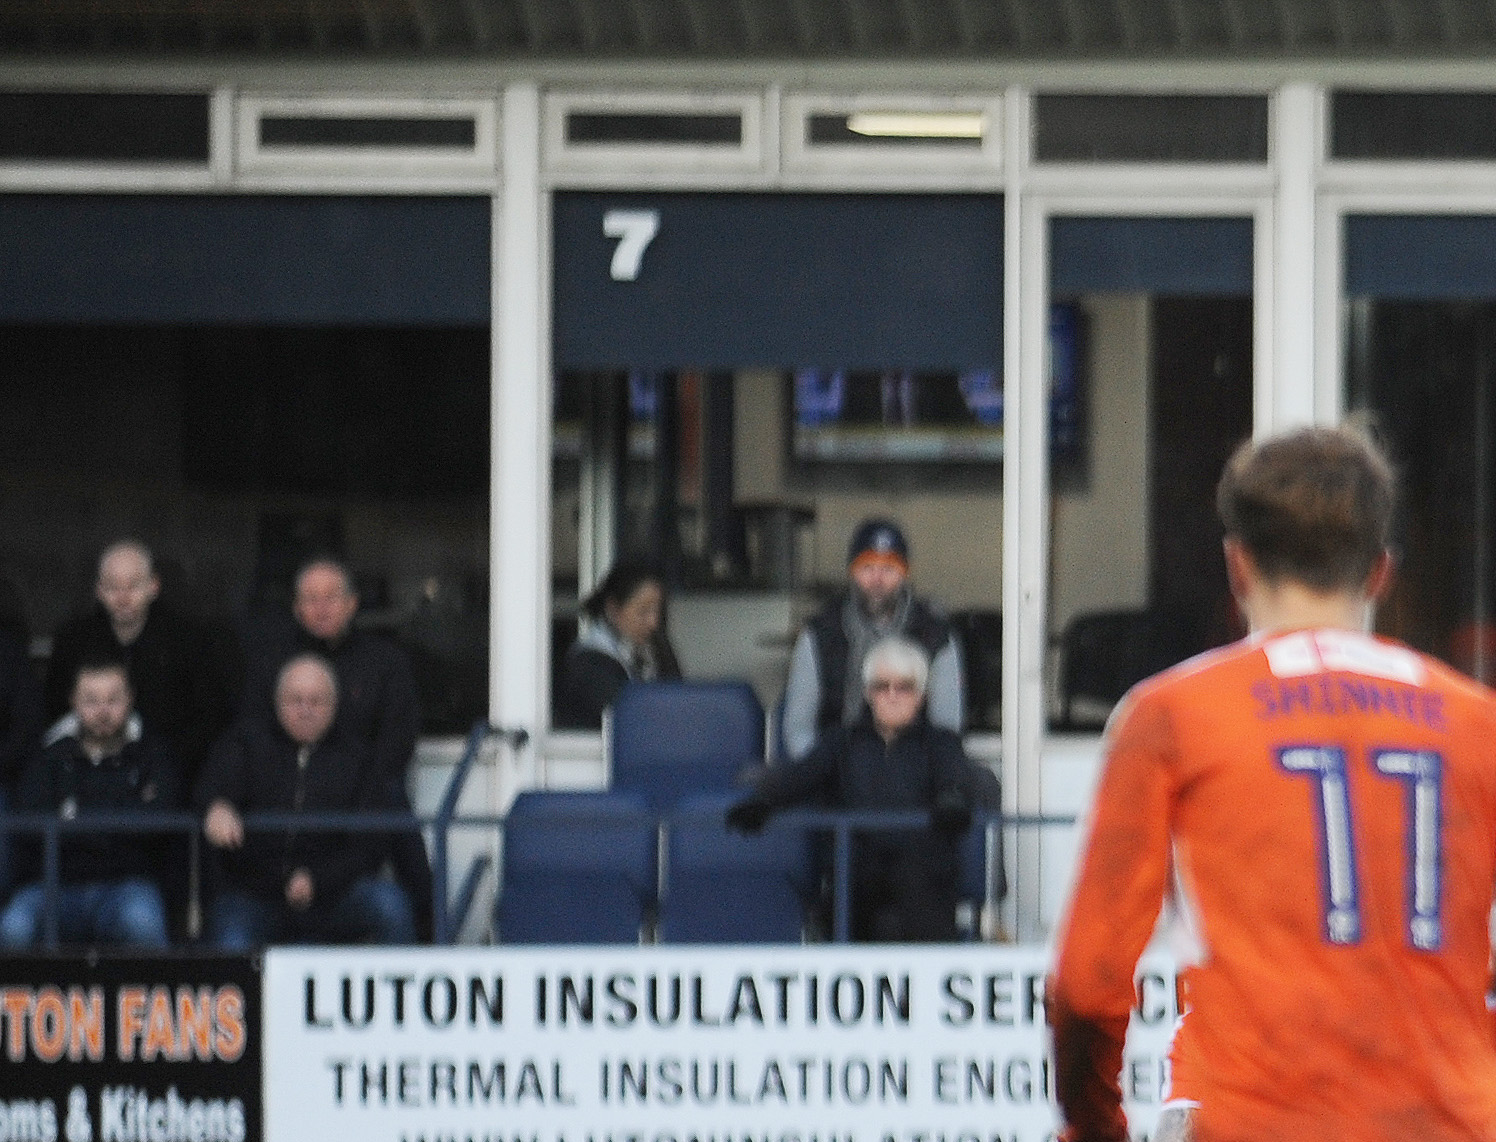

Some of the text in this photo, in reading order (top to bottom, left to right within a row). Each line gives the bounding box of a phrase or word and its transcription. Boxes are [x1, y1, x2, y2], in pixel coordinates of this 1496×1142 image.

[602, 208, 660, 281] 7
[1266, 744, 1446, 954] 11
[117, 984, 247, 1063] FANS
[303, 973, 503, 1029] LUTON
[536, 971, 912, 1028] INSULATION
[327, 1058, 577, 1108] THERMAL
[600, 1057, 911, 1105] INSULATION
